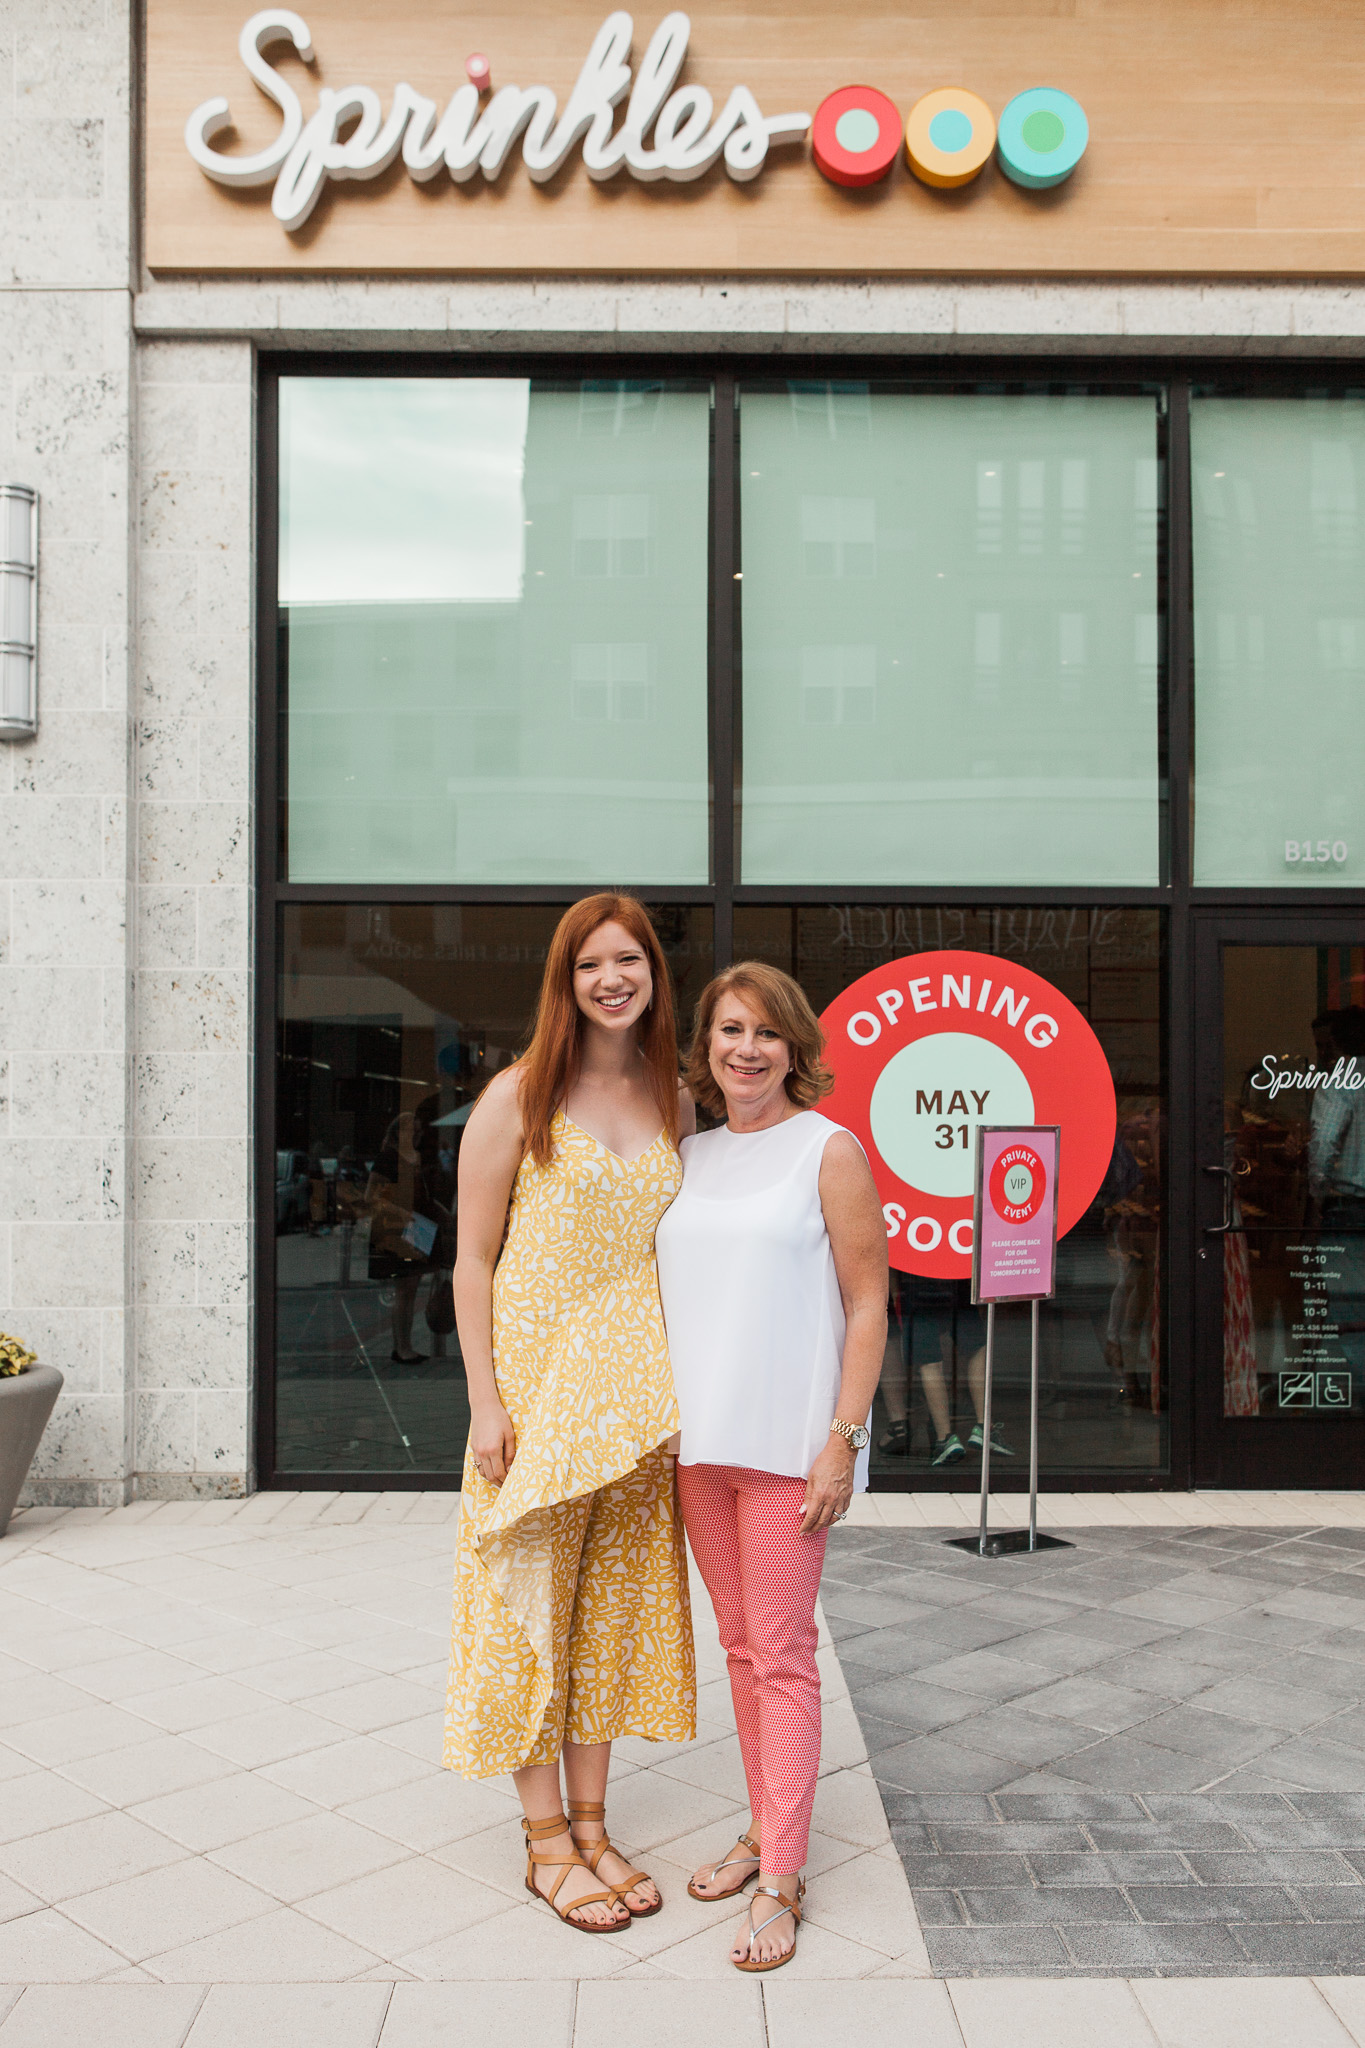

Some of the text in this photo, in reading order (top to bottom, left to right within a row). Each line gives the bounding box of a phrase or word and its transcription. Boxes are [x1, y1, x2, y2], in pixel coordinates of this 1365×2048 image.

[185, 9, 812, 232] Sprinkles
[1285, 840, 1348, 862] B150
[846, 974, 1059, 1049] OPENING
[1251, 1055, 1365, 1099] Sprinkle
[916, 1089, 990, 1115] MAY
[934, 1124, 969, 1149] 31
[1000, 1150, 1037, 1168] PRIVATE
[1010, 1178, 1027, 1190] VIP
[1003, 1203, 1033, 1219] EVENT
[882, 1202, 975, 1255] SOO
[991, 1240, 1010, 1248] PLEASE
[1014, 1258, 1037, 1266] OPENING
[990, 1269, 1020, 1277] TOMORROW
[1303, 1298, 1328, 1306] sunday
[1312, 1348, 1328, 1356] pets
